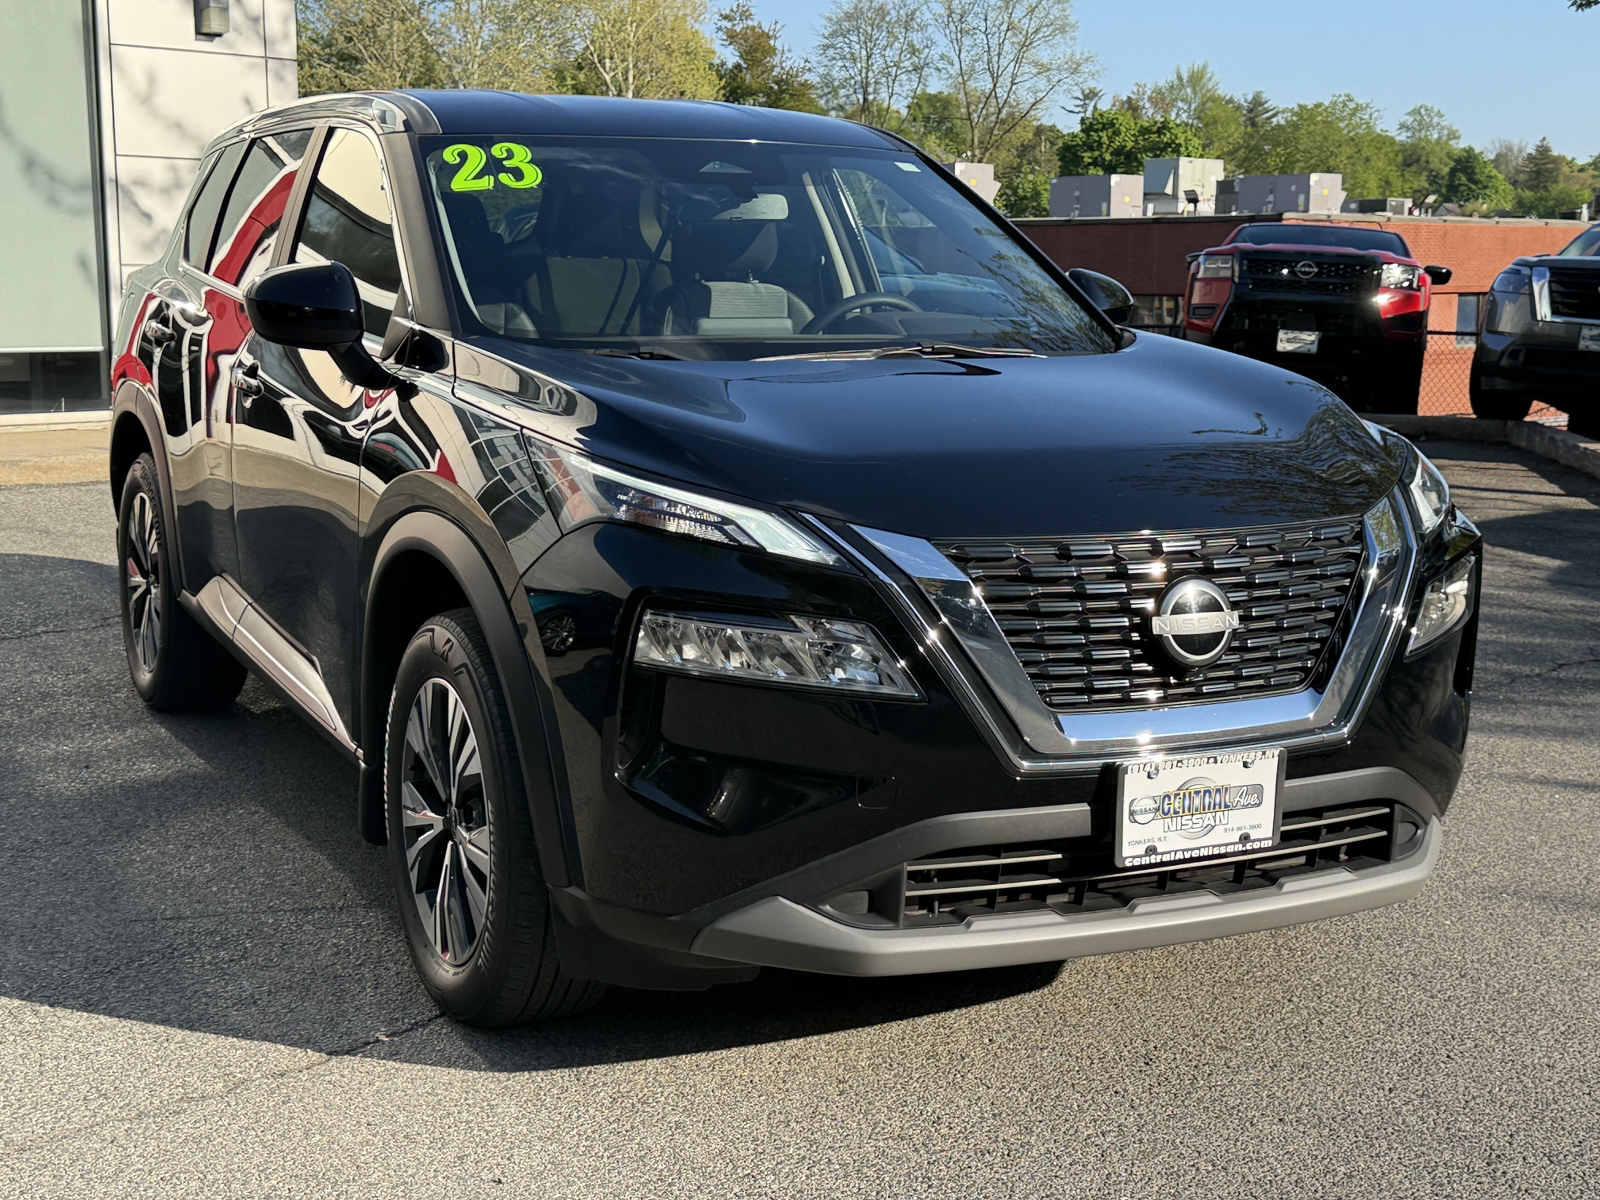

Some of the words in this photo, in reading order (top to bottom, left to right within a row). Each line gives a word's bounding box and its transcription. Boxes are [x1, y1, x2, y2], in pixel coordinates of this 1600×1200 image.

[442, 142, 543, 191] 23
[1154, 614, 1238, 633] NISSAN
[1131, 805, 1158, 815] NISSAN
[1161, 785, 1231, 818] CENTRAL
[1232, 786, 1260, 807] Ave.
[1163, 810, 1229, 833] NISSAN
[1124, 840, 1273, 867] CentralAveNissan.com
